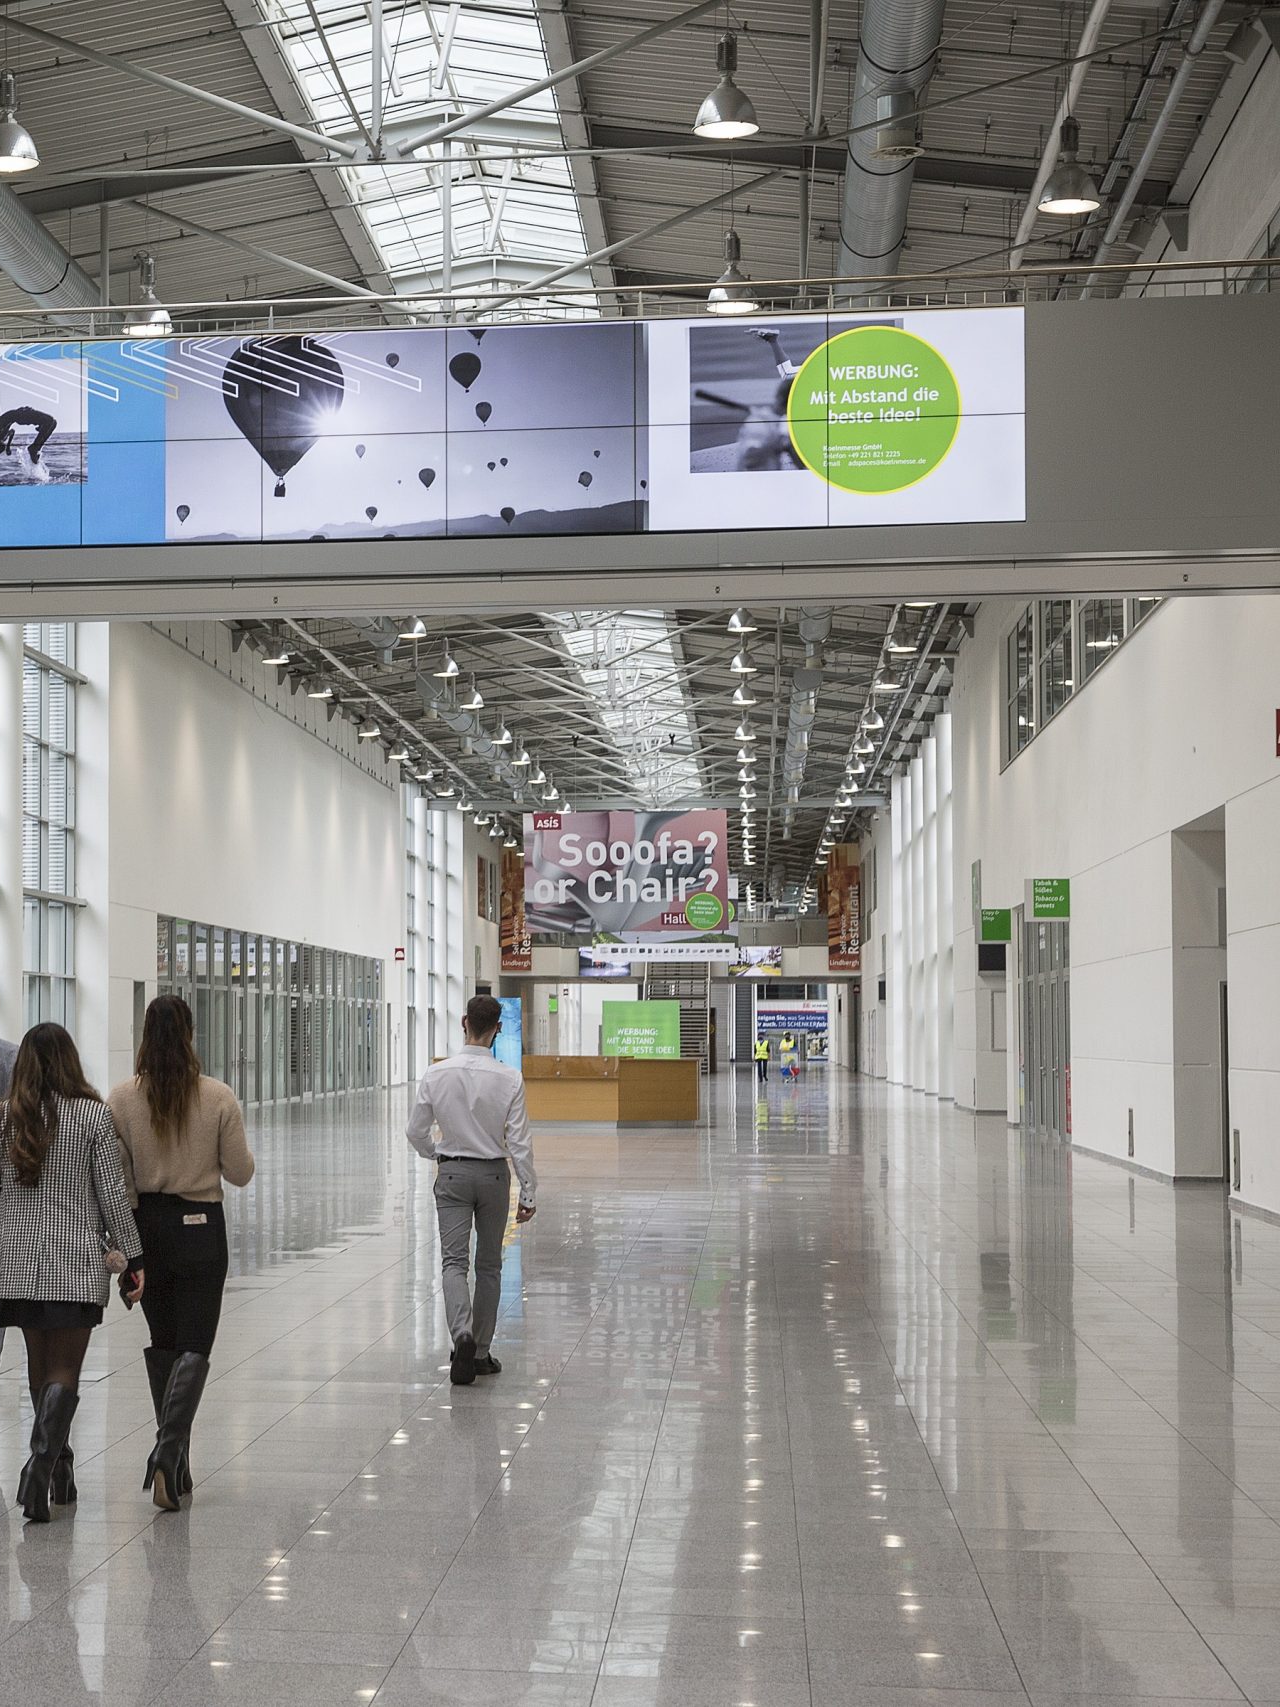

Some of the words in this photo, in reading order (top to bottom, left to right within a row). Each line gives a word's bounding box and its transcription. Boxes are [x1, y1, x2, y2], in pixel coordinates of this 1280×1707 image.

[829, 364, 919, 380] WERBUNG:
[810, 390, 836, 405] Mit
[841, 388, 907, 404] Abstand
[913, 386, 939, 401] die
[828, 409, 873, 424] beste
[879, 407, 921, 423] Idee!
[558, 831, 719, 867] Sooofa?
[533, 878, 577, 904] or
[587, 868, 719, 904] Chair?
[663, 914, 687, 925] Hall
[848, 885, 859, 955] Restaurant
[829, 959, 860, 967] Lindbergh
[617, 1027, 658, 1036] WERBUNG:
[607, 1037, 619, 1045] MIT
[621, 1037, 655, 1045] ABSTAND
[617, 1046, 628, 1054] DIE
[632, 1046, 653, 1054] BESTE
[656, 1046, 675, 1054] IDEE!
